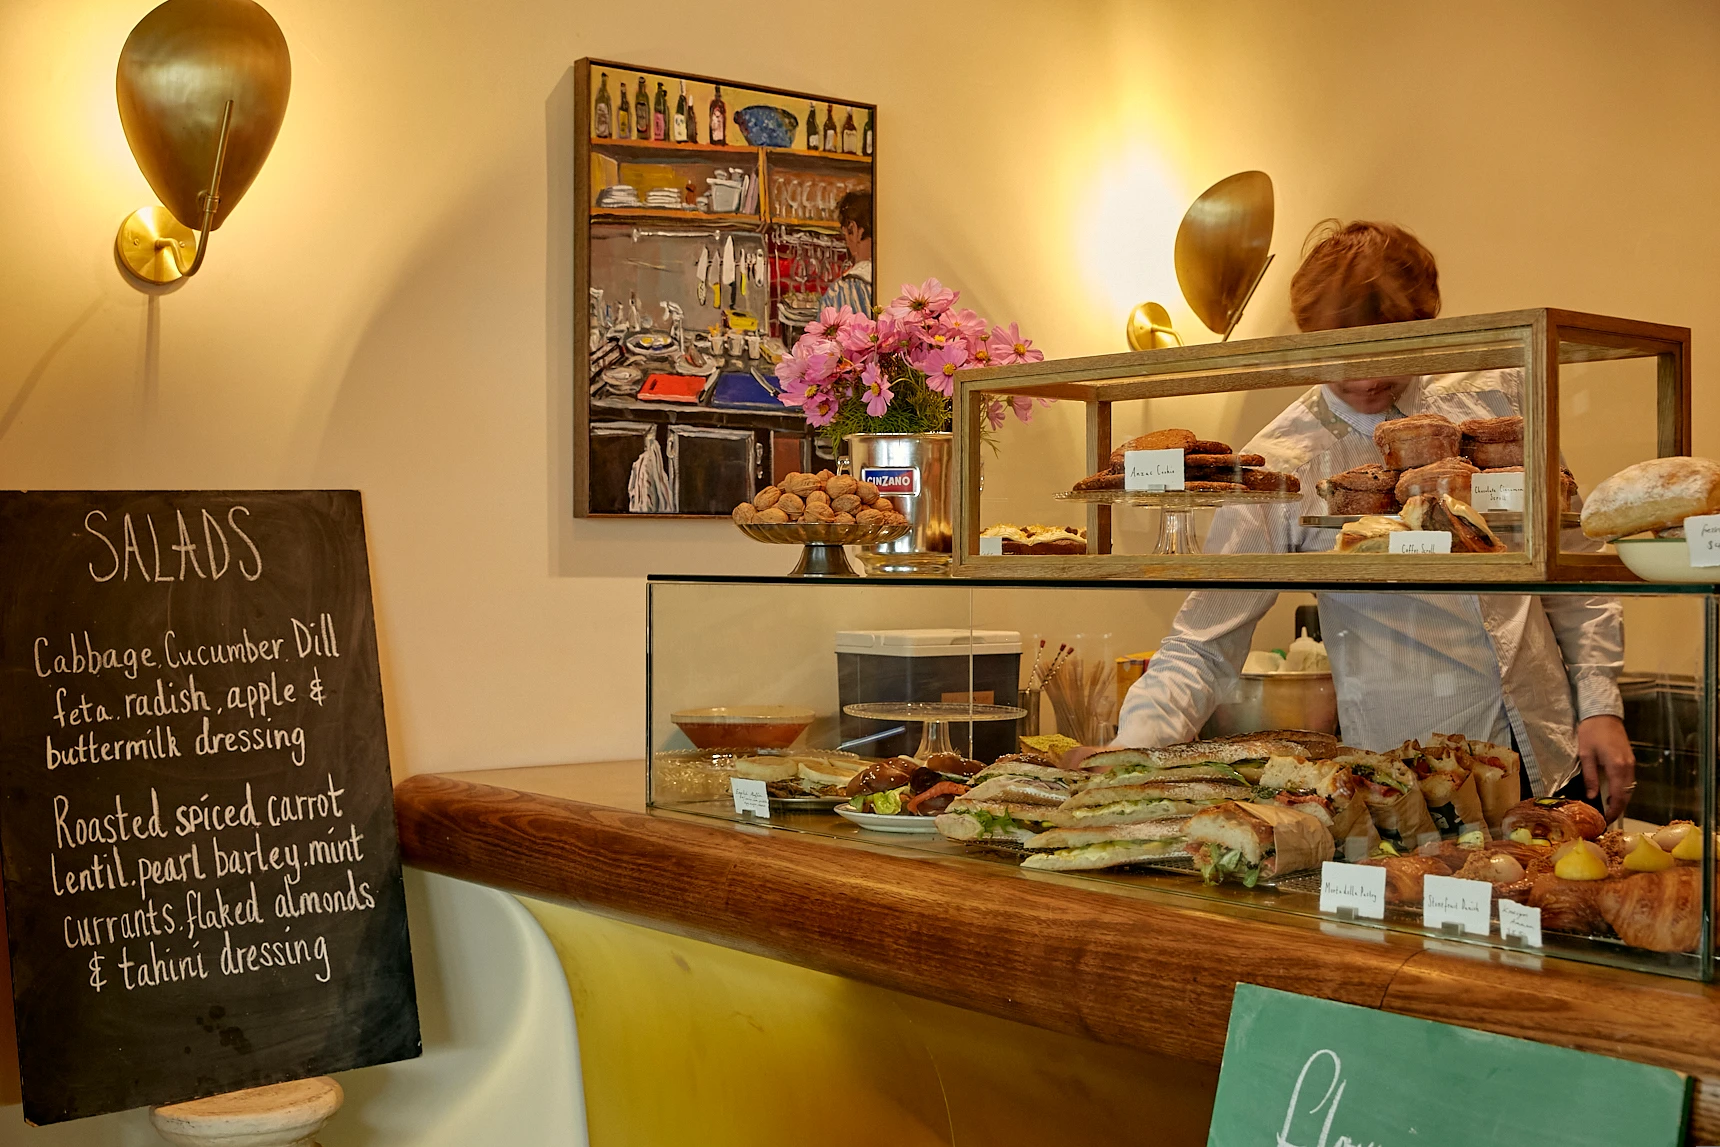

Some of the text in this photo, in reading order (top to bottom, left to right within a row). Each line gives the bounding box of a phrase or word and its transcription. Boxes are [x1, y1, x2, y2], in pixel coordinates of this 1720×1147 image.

[867, 476, 910, 487] CINZANO
[84, 505, 263, 583] SALADS
[290, 612, 341, 660] Dill
[226, 671, 298, 718] apple
[309, 666, 327, 707] &
[46, 716, 307, 771] buttermilk dressing
[53, 772, 346, 850] Roasted spiced carrot
[274, 869, 377, 920] almonds
[88, 925, 333, 993] & tahini dressing
